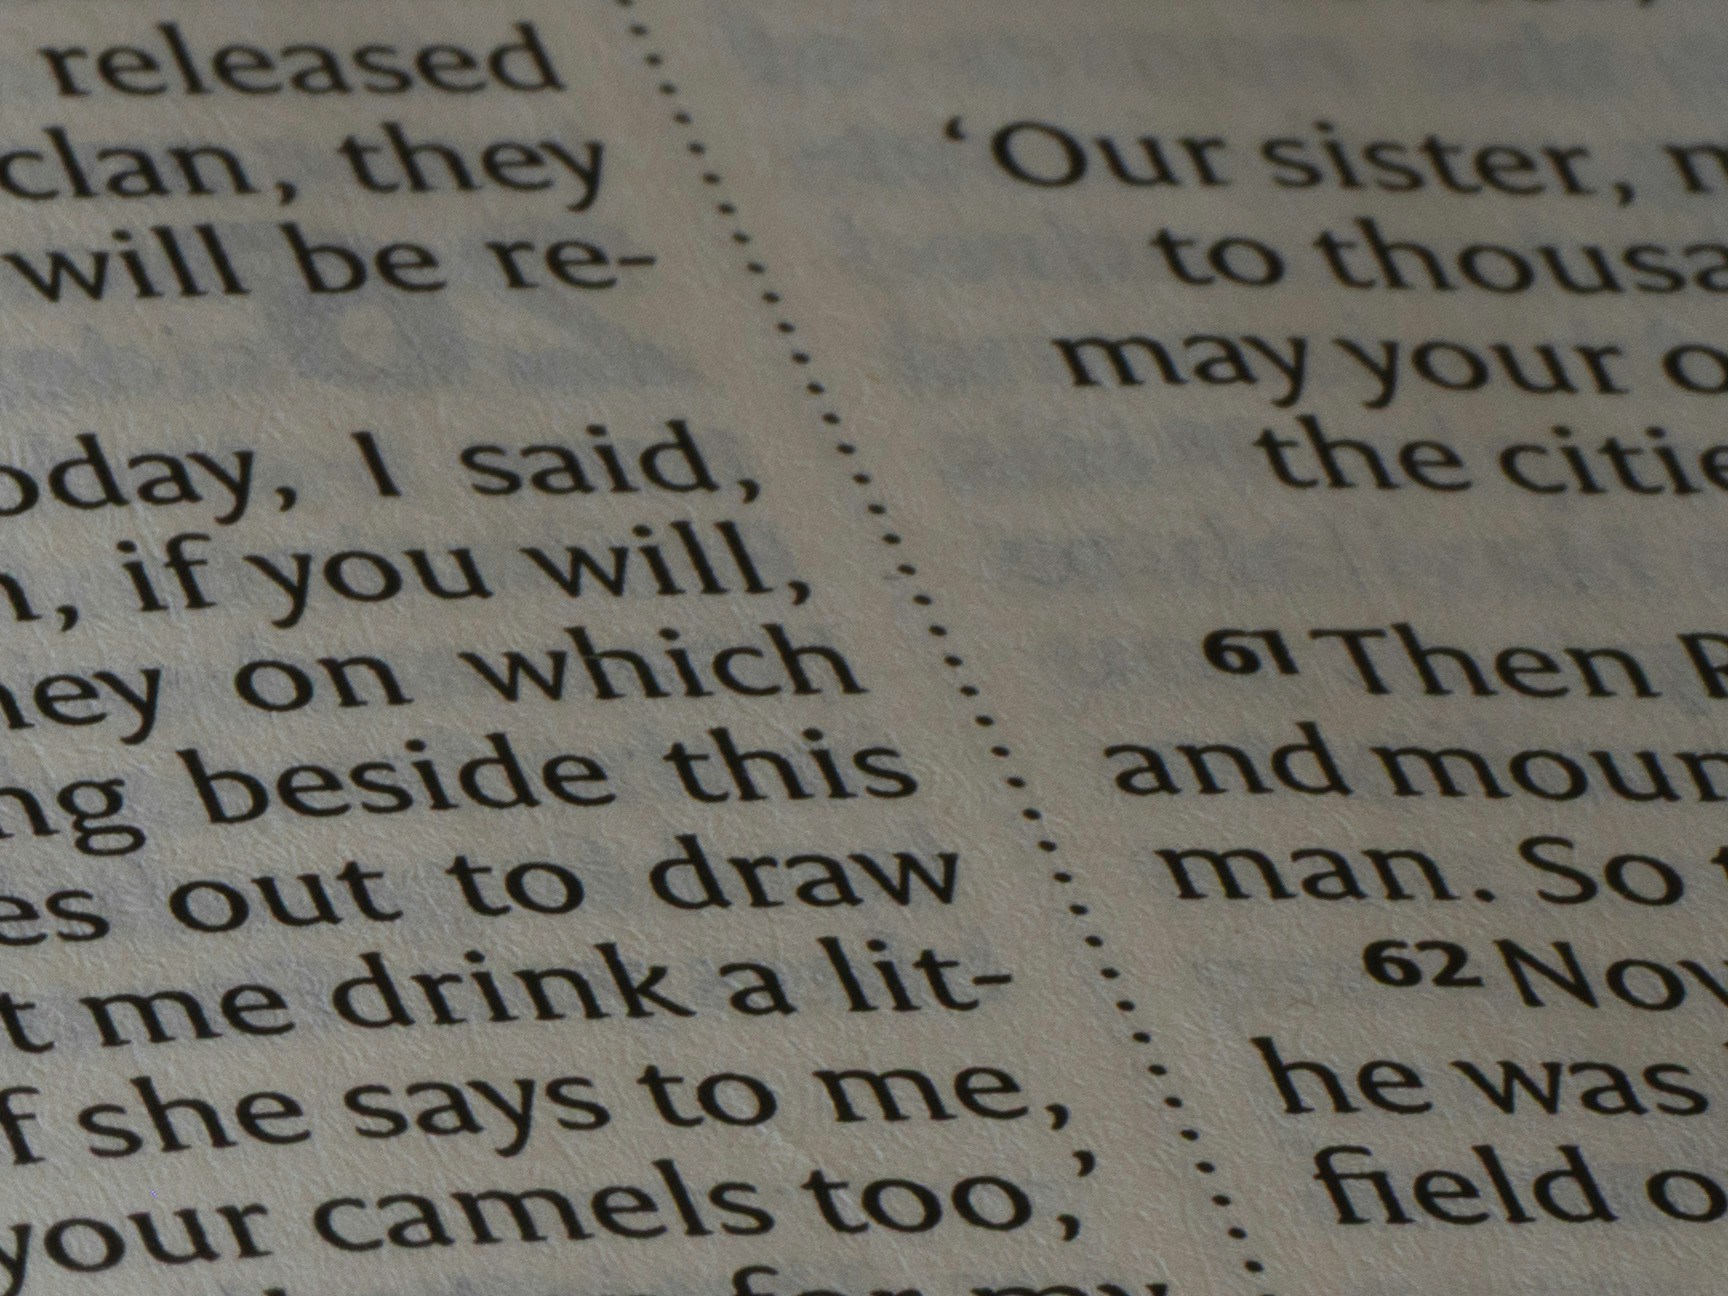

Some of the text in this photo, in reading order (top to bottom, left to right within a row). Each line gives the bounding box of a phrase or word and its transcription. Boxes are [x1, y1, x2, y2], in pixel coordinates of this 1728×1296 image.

[334, 119, 607, 215] they
[1258, 118, 1638, 209] sister,
[276, 219, 449, 298] be
[482, 237, 658, 293] re-
[1147, 226, 1288, 290] to
[1049, 332, 1630, 412] may your
[348, 428, 404, 500] I
[457, 416, 763, 507] said,
[1250, 411, 1475, 495] the
[113, 530, 219, 615] if
[240, 545, 496, 632] you
[516, 517, 813, 609] will,
[231, 653, 417, 716] on
[455, 620, 871, 705] which
[1101, 718, 1356, 800] and
[166, 858, 406, 936] out
[442, 852, 588, 920] to
[646, 831, 961, 913] draw
[1151, 832, 1688, 910] man. So
[75, 981, 298, 1051] me
[329, 939, 699, 1032] drink
[716, 959, 800, 1019] a
[814, 933, 1016, 1016] lit-
[1247, 1033, 1712, 1120] he was
[310, 1156, 778, 1255] camels
[1310, 1141, 1622, 1229] field
